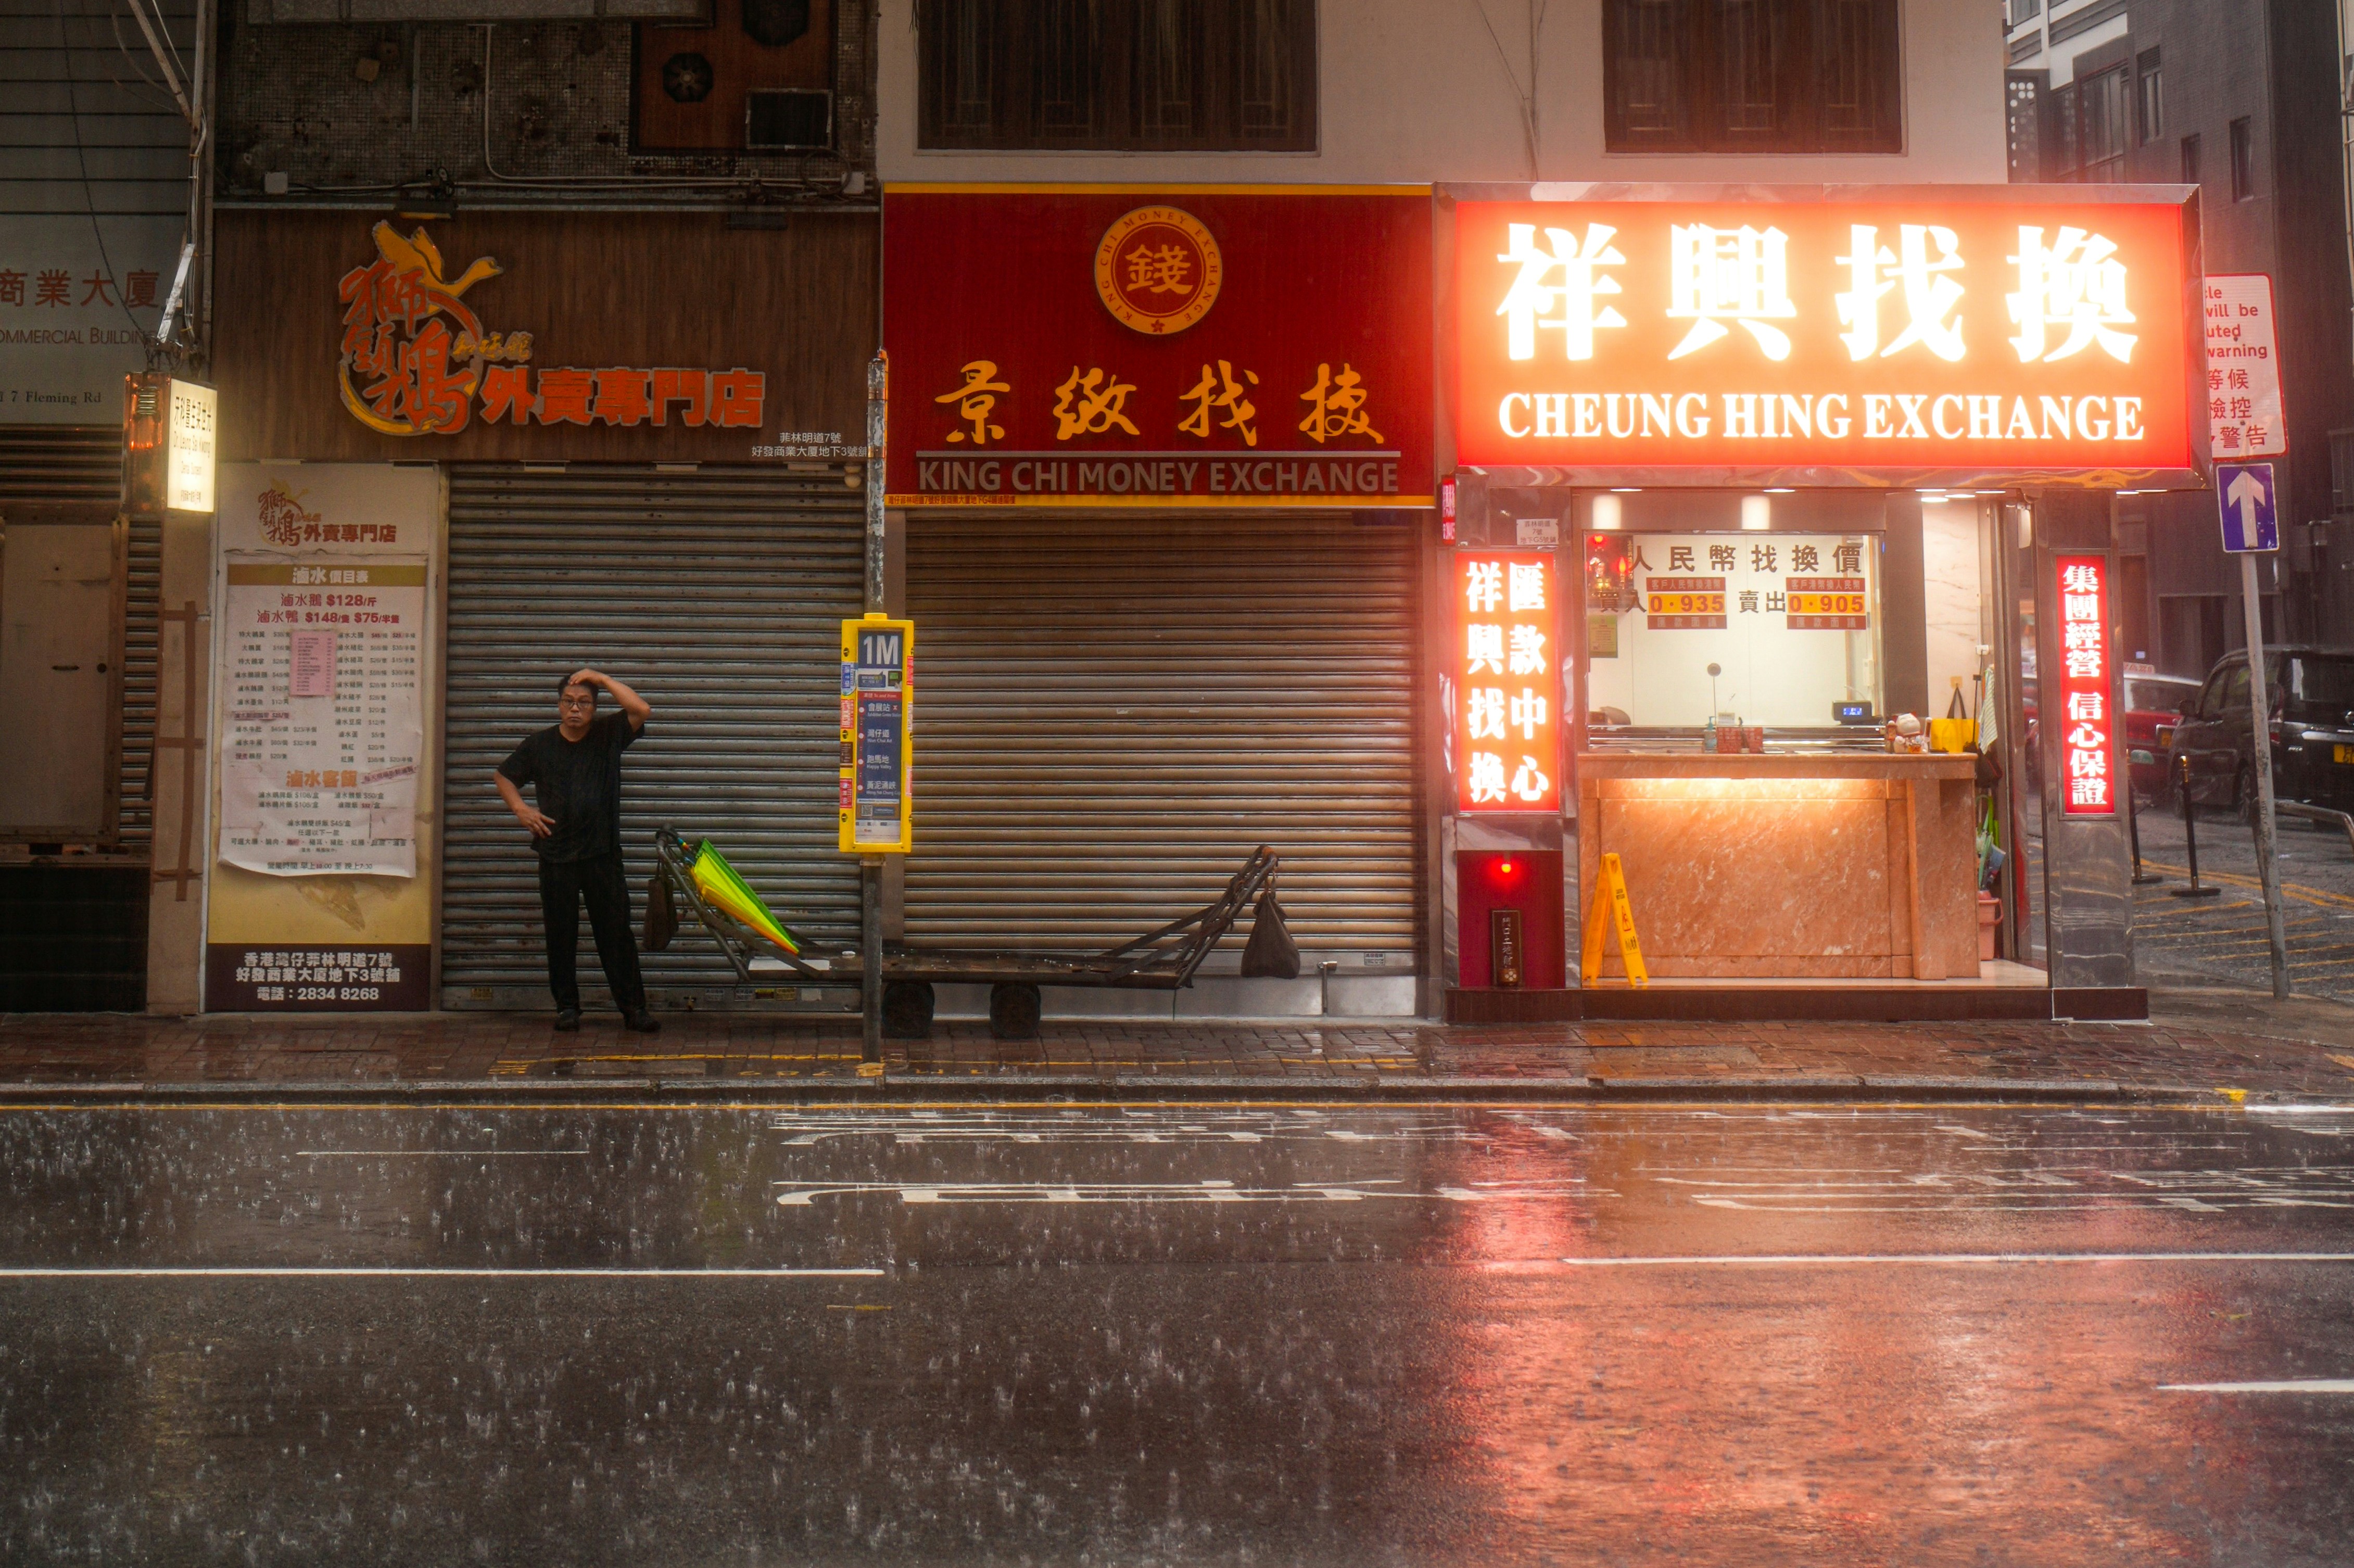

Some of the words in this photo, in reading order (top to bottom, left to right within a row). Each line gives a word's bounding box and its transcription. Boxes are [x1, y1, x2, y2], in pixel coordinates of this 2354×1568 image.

[1123, 210, 1187, 229] MONEY
[1100, 235, 1118, 266] CHI
[1125, 244, 1194, 295] 錢
[1184, 229, 1218, 322] EXCHANGE
[0, 268, 159, 308] 商業大廈
[1101, 280, 1133, 321] KING
[1496, 223, 2137, 364] 祥興找換
[2206, 286, 2222, 299] le
[2239, 304, 2258, 317] be
[26, 391, 77, 404] Fleming
[84, 392, 101, 402] Rd
[479, 365, 766, 428] 外賣專門店
[1498, 392, 1711, 440] CHEUNG
[1722, 394, 1852, 440] HING
[1863, 394, 2146, 441] EXCHANGE
[780, 433, 841, 443] 菲林明道7號
[2211, 425, 2267, 448] 警告
[919, 461, 1002, 491] KING
[1011, 462, 1069, 491] CHI
[1078, 462, 1199, 491] MONEY
[1210, 462, 1400, 492] EXCHANGE
[304, 523, 397, 542] 外賣專門店
[1629, 544, 1863, 573] 人民幣找換價
[1739, 590, 1786, 613] 賣出
[2063, 565, 2102, 678] 集團經營
[863, 635, 898, 665] 1M
[1465, 561, 1507, 803] 祥興找換
[1508, 562, 1550, 802] 匯款中心
[867, 729, 890, 738] 灣仔道
[2067, 692, 2107, 805] 信心保證
[867, 755, 890, 764] 跑馬地
[244, 952, 393, 967] 香港灣仔菲林明道7號
[297, 987, 335, 1000] 2834
[340, 987, 379, 1000] 8268
